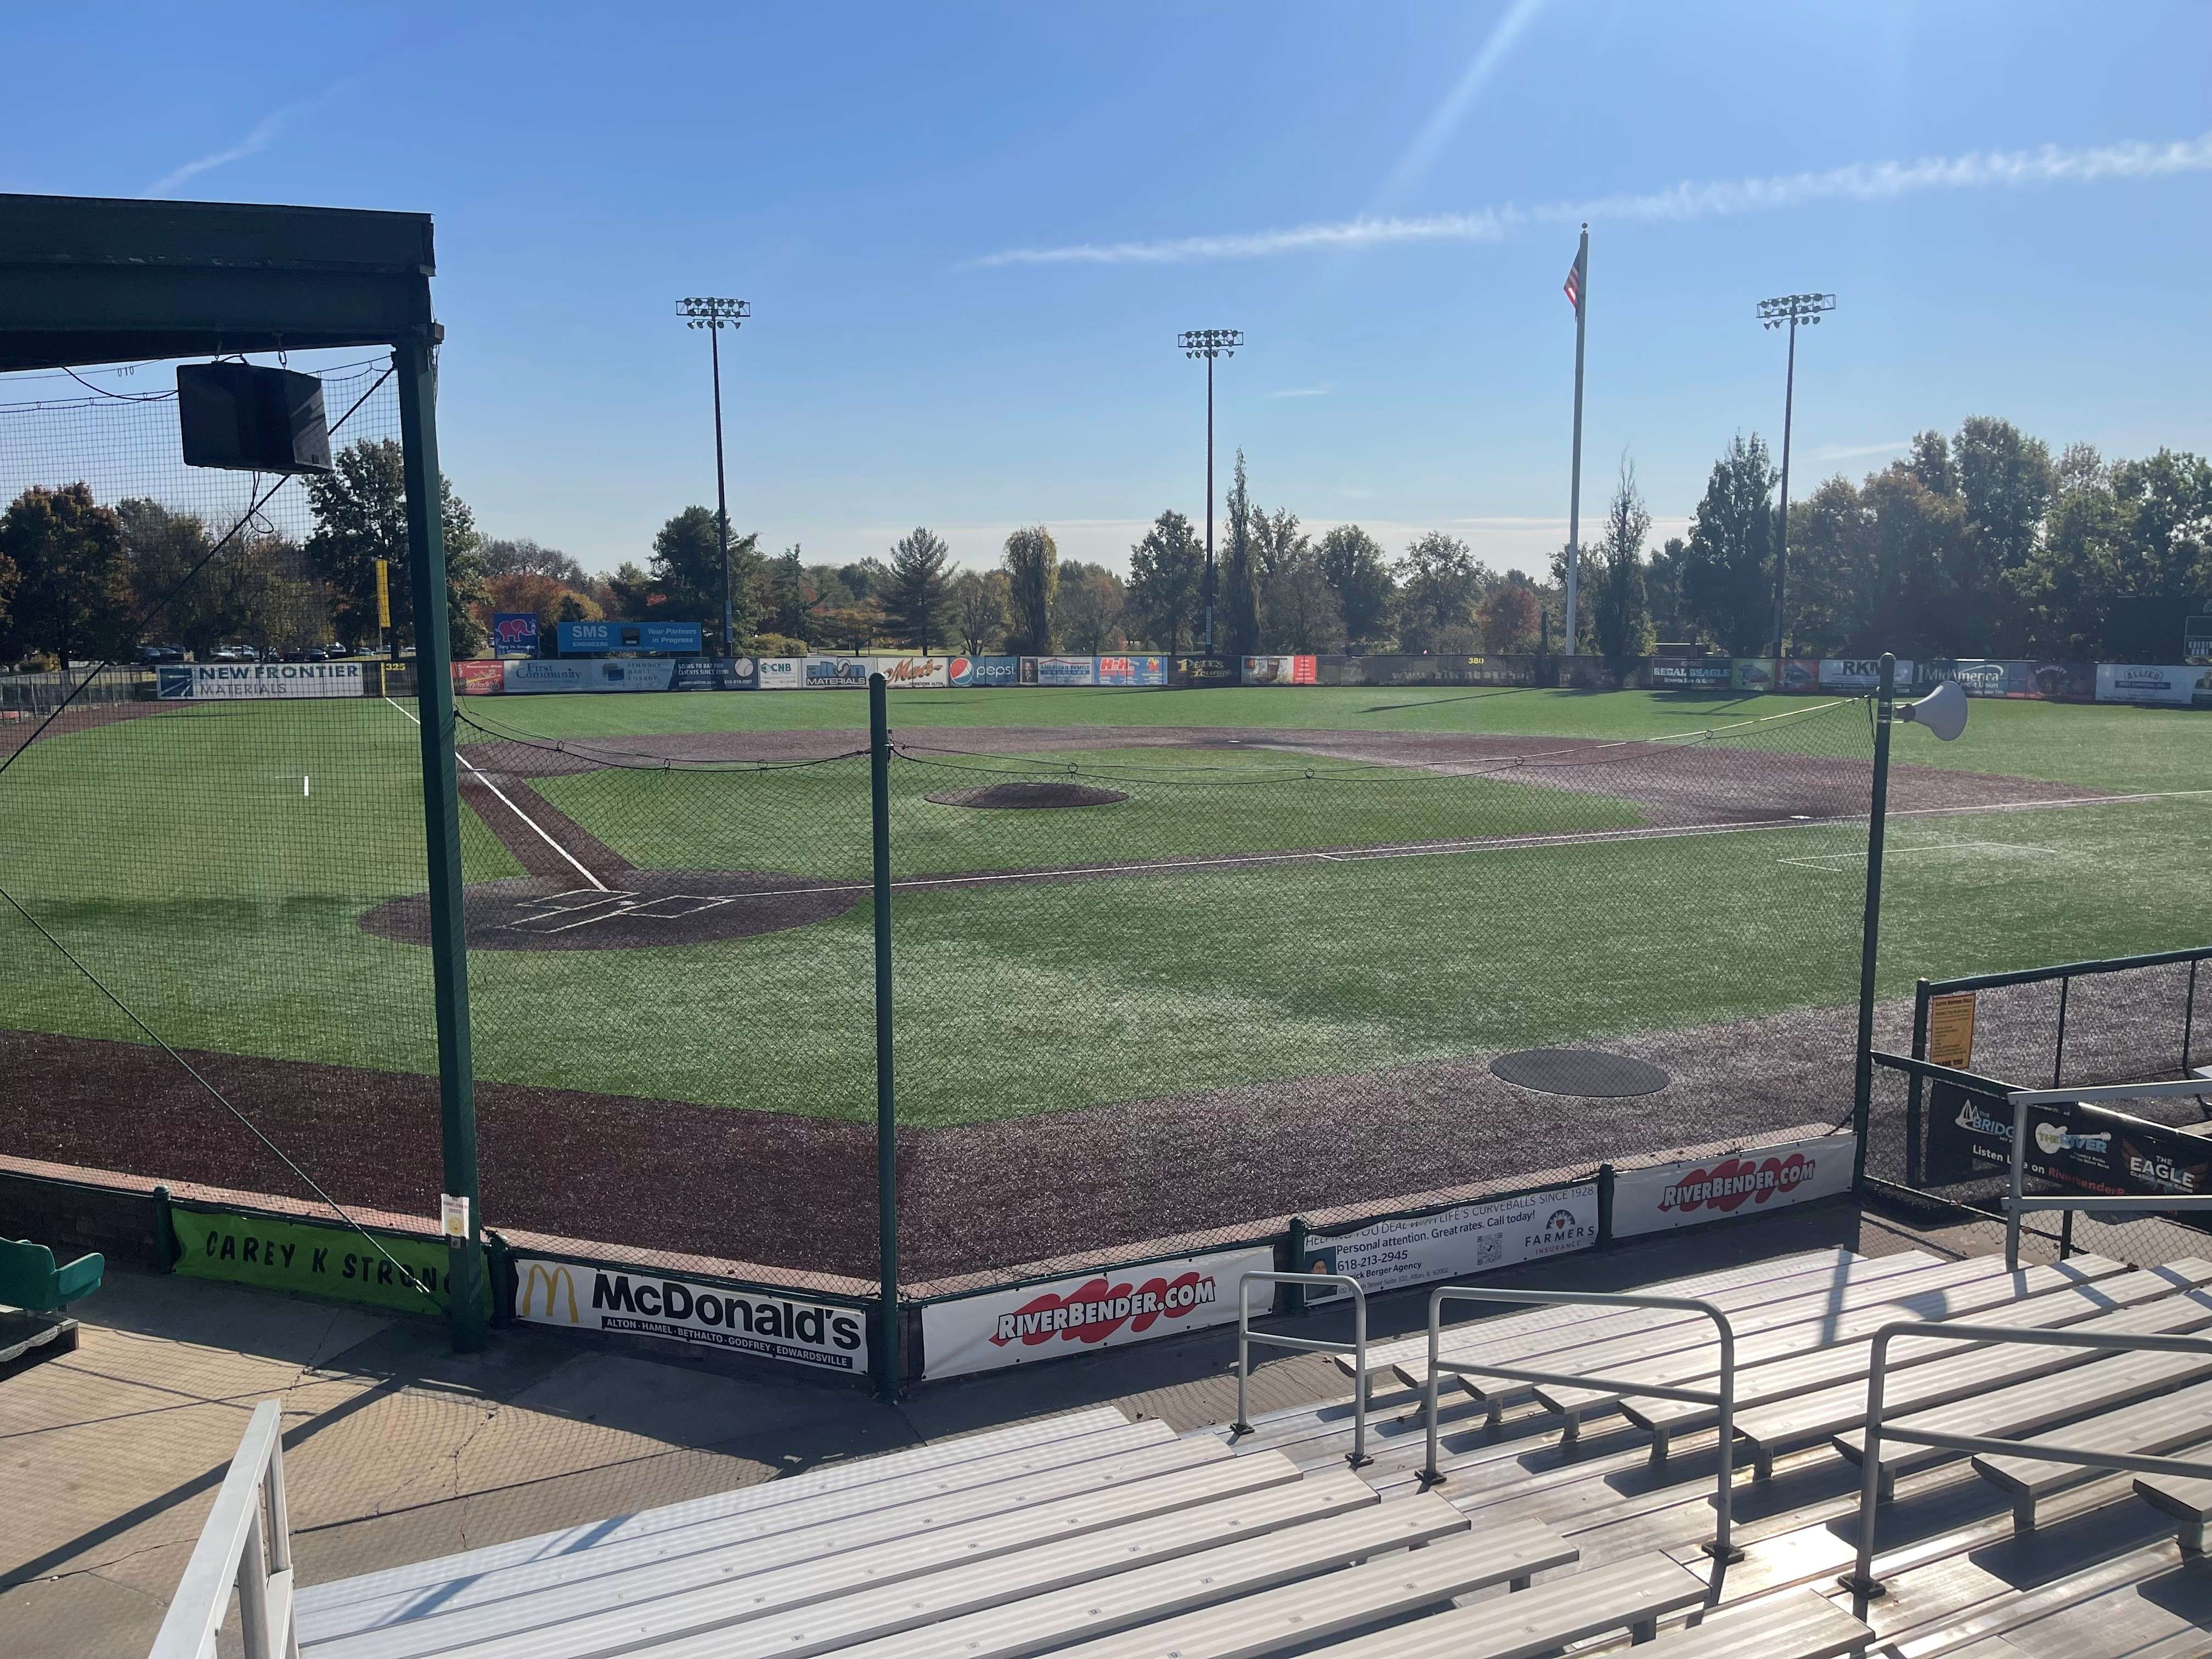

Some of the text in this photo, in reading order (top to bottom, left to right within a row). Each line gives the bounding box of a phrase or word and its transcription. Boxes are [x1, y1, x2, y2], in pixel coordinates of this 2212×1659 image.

[572, 625, 608, 638] SMS
[199, 665, 358, 679] NEW FRONTIER
[516, 667, 581, 679] Community
[527, 663, 552, 672] First
[771, 663, 792, 672] CNB
[976, 663, 1015, 678] pepsi
[1654, 668, 1730, 677] REGAL BEAGLE
[1925, 668, 1998, 681] MidAmerica
[2127, 669, 2160, 680] ALLIED
[201, 684, 286, 696] MATERIALS
[2039, 1133, 2107, 1154] THE RIVER
[1973, 1144, 2003, 1162] Listen
[2007, 1154, 2028, 1169] Le
[2032, 1164, 2045, 1175] on
[2156, 1155, 2172, 1166] THE
[2130, 1156, 2195, 1188] EAGLE
[1440, 1209, 1469, 1223] LIFE'S
[1472, 1197, 1536, 1216] CURVEBALLS
[1539, 1189, 1568, 1205] SINCE
[1571, 1186, 1597, 1199] 1928.
[1337, 1210, 1536, 1255] Personal attention. Great rates. Call today!
[1525, 1226, 1594, 1247] FARMERS
[206, 1229, 296, 1269] CAREY
[312, 1247, 329, 1274] K
[1536, 1240, 1581, 1255] INSURANCE
[1338, 1250, 1408, 1272] 618-213-2945
[1366, 1268, 1392, 1277] Berger
[1393, 1262, 1422, 1273] Agency
[1367, 1280, 1384, 1289] Street
[1433, 1268, 1449, 1276] 62002
[592, 1274, 861, 1350] McDonald's
[607, 1318, 847, 1367] ALTON HAMEL BETHALTO GODFREY EDWARDSVILLE
